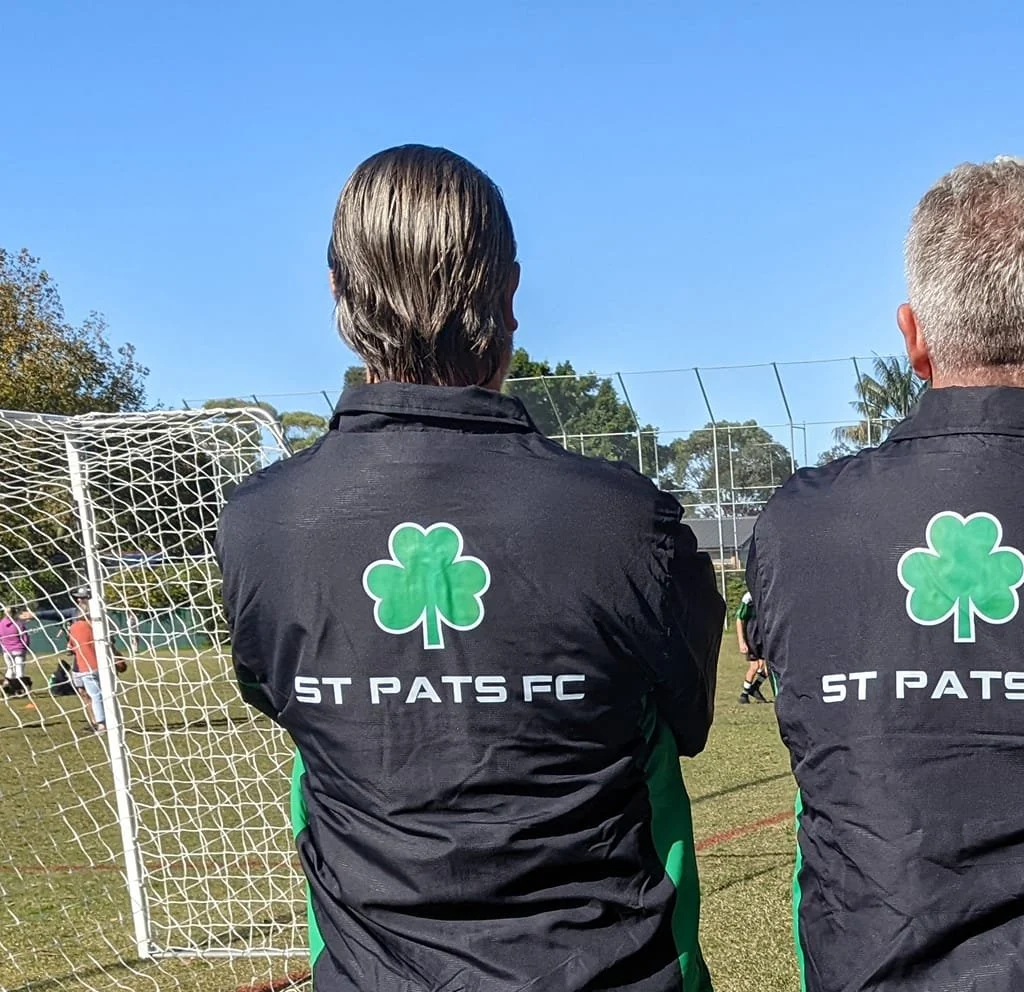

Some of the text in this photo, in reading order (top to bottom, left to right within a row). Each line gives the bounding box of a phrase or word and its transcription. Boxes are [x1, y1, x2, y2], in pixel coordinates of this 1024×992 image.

[294, 674, 585, 705] ST PATS FC
[822, 671, 877, 703] ST
